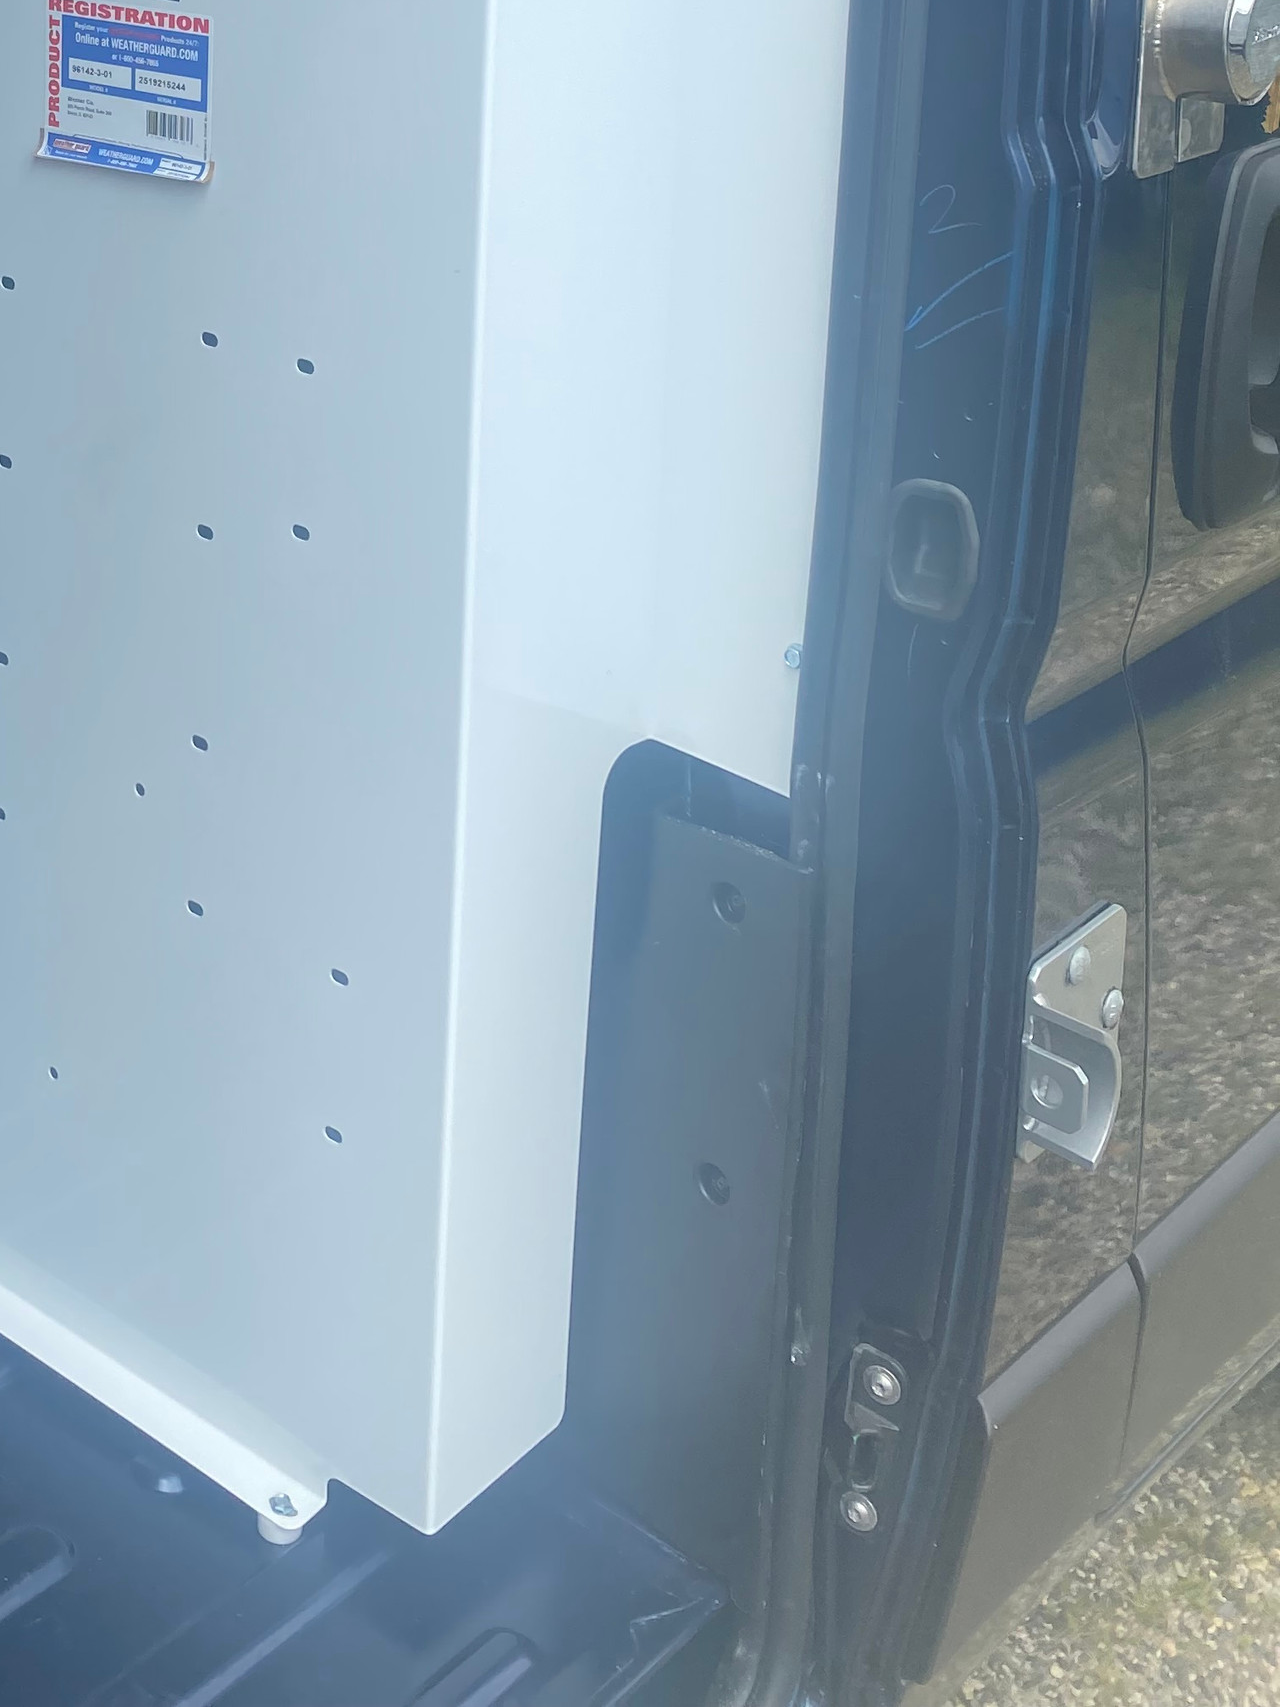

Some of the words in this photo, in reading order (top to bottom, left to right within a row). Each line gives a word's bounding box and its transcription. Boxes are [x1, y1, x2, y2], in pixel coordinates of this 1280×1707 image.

[74, 22, 95, 32] Register
[75, 32, 100, 46] Online
[101, 37, 110, 47] at
[111, 38, 198, 61] WEATHERGUARD.COM
[160, 35, 185, 45] Products
[48, 14, 61, 128] PRODUCT
[71, 64, 113, 78] 96142-3-01
[138, 76, 186, 91] 2519215244
[98, 148, 154, 166] WEATHERGUARD.COM
